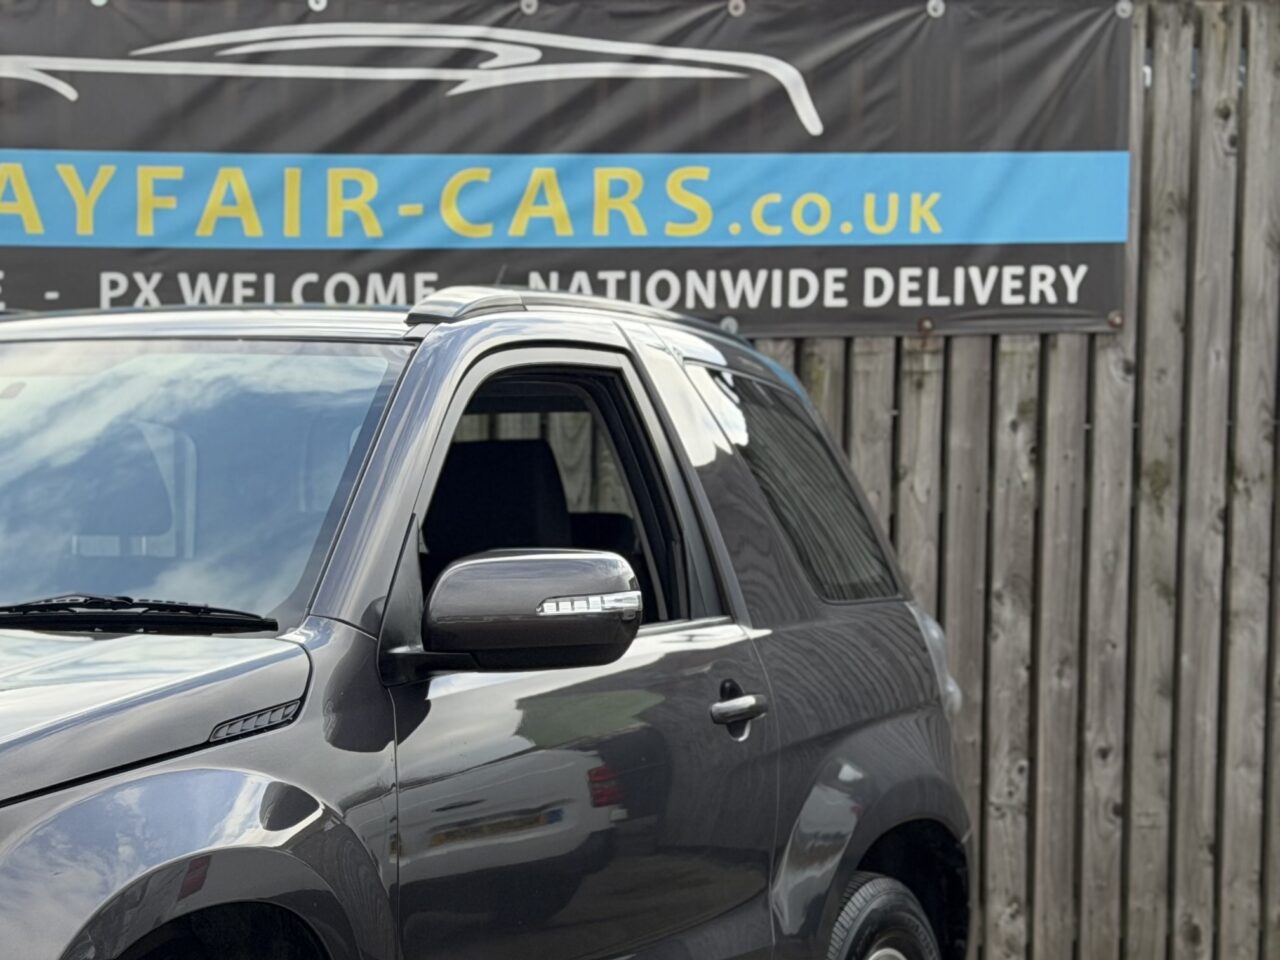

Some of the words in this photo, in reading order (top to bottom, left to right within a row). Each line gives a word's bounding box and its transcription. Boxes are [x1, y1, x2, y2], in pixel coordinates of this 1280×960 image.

[99, 272, 163, 309] PX
[176, 271, 440, 306] WELCOME
[527, 268, 849, 310] NATIONWIDE
[862, 264, 1089, 308] DELIVERY
